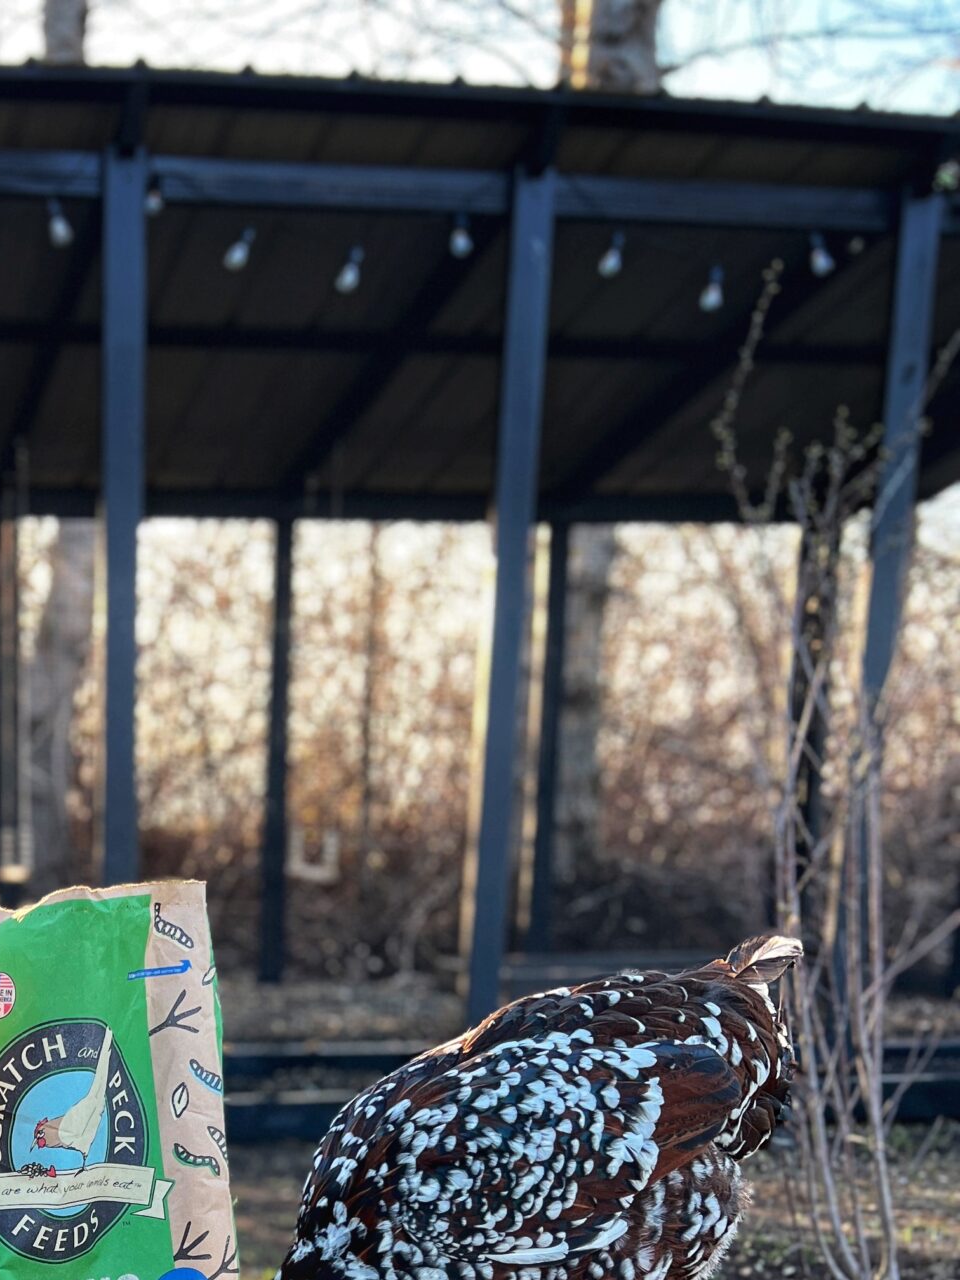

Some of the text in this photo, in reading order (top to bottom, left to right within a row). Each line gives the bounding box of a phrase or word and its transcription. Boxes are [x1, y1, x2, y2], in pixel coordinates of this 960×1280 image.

[77, 1046, 99, 1059] and
[108, 1070, 135, 1155] PECK
[1, 1187, 20, 1196] are
[27, 1183, 58, 1194] what
[61, 1182, 84, 1199] your
[11, 1209, 99, 1252] FEEDS
